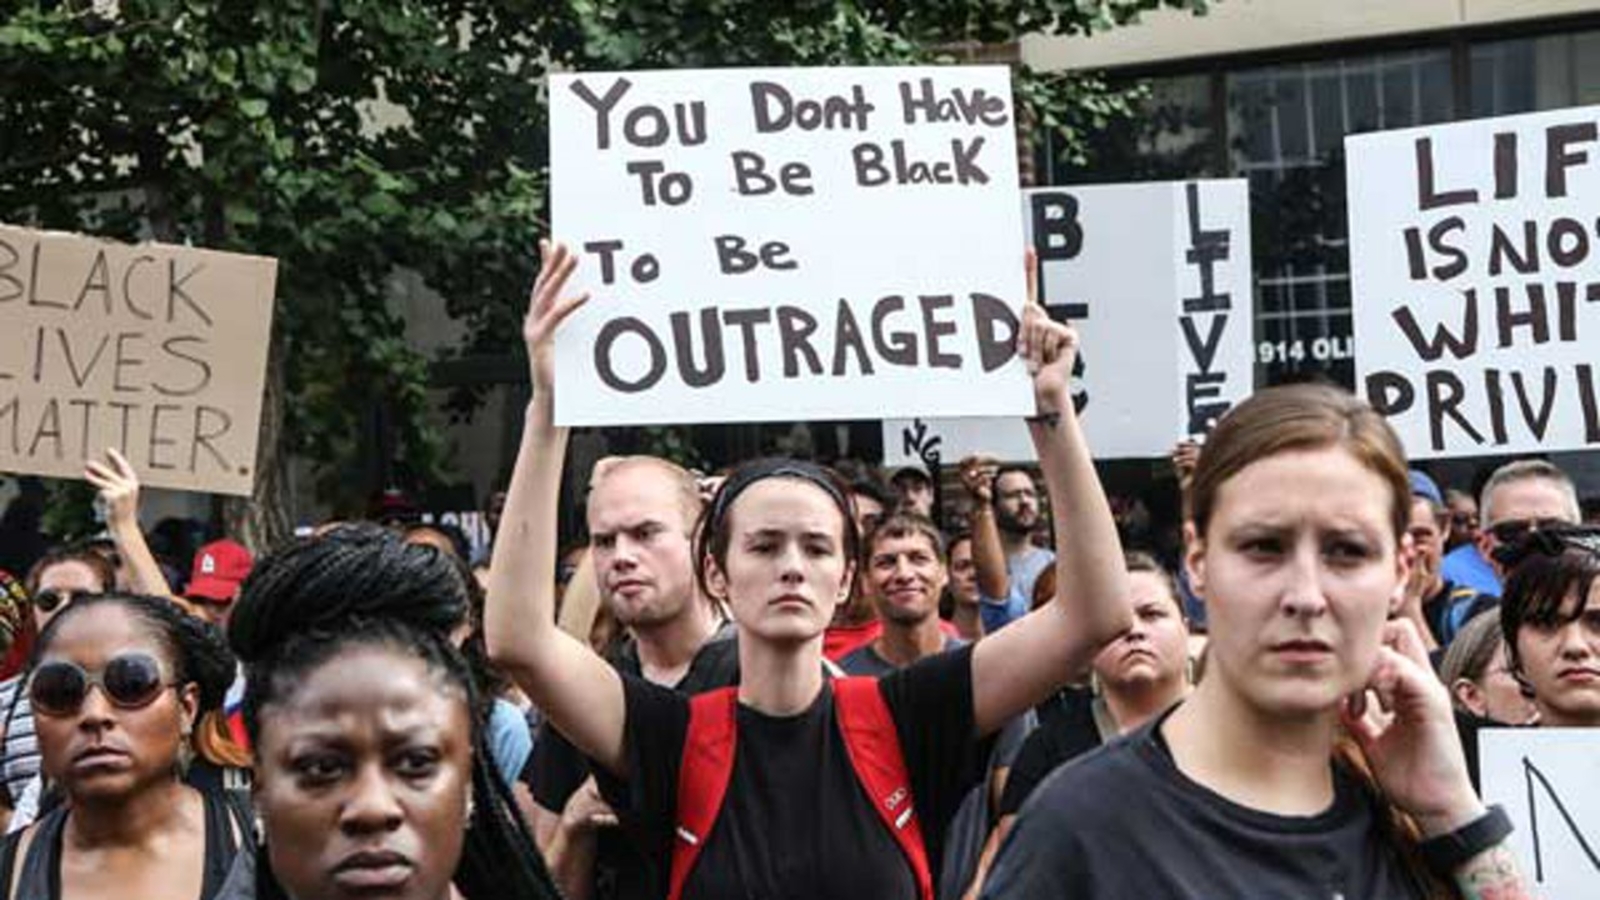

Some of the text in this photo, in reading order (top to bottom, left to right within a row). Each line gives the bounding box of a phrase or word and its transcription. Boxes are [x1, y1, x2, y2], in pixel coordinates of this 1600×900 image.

[569, 77, 1008, 150] You Dont Have
[626, 160, 693, 206] To
[731, 150, 814, 197] Be
[584, 235, 798, 285] To Be
[1403, 215, 1600, 282] IS NO
[0, 326, 212, 396] IVES
[593, 292, 1020, 394] OUTRAGED
